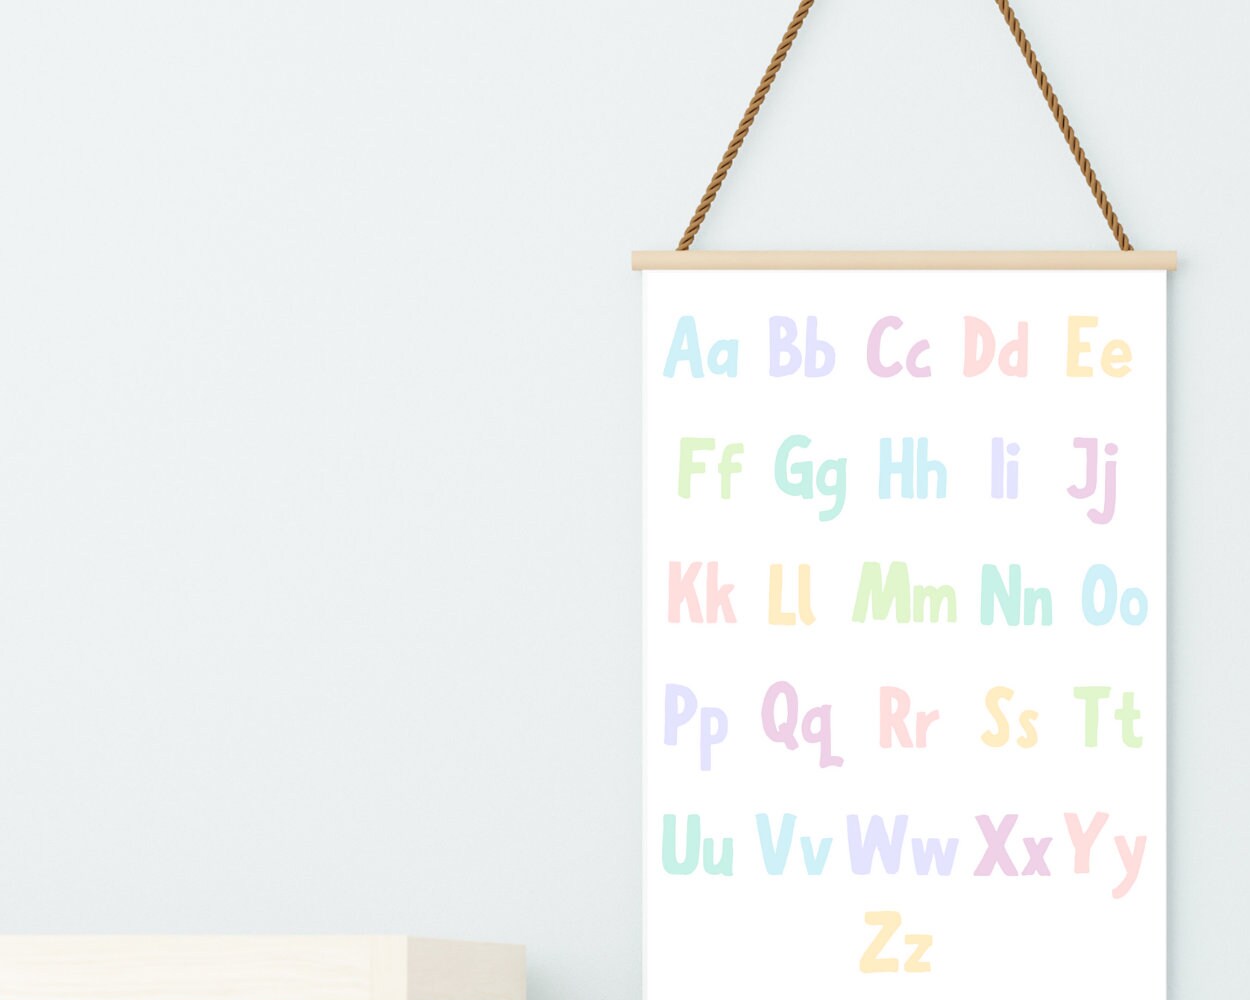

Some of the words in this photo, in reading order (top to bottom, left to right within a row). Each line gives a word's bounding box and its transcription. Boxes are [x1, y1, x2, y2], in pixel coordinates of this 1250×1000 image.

[663, 315, 739, 379] Aa
[769, 316, 835, 377] Bb
[867, 316, 931, 378] Cc
[963, 315, 1028, 377] Dd
[1065, 314, 1133, 378] Ee
[677, 436, 744, 500] Ff
[774, 434, 847, 523] Gg
[878, 436, 948, 500] Hh
[992, 437, 1020, 499] Ii
[1067, 437, 1117, 524] Jj
[668, 561, 736, 624] Kk
[768, 562, 816, 628] Ll
[851, 560, 957, 624] Mm
[980, 563, 1053, 627] Nn
[1081, 563, 1148, 627] Oo
[664, 683, 728, 771] Pp
[761, 681, 844, 768] Qq
[880, 686, 940, 749] Rr
[980, 685, 1040, 749] Ss
[1073, 685, 1144, 749] Tt
[662, 813, 734, 877] Uu
[755, 812, 832, 876] Vv
[847, 814, 959, 876] Ww
[974, 814, 1052, 876] Xx
[1064, 811, 1147, 899] Yy
[858, 910, 934, 974] Zz
